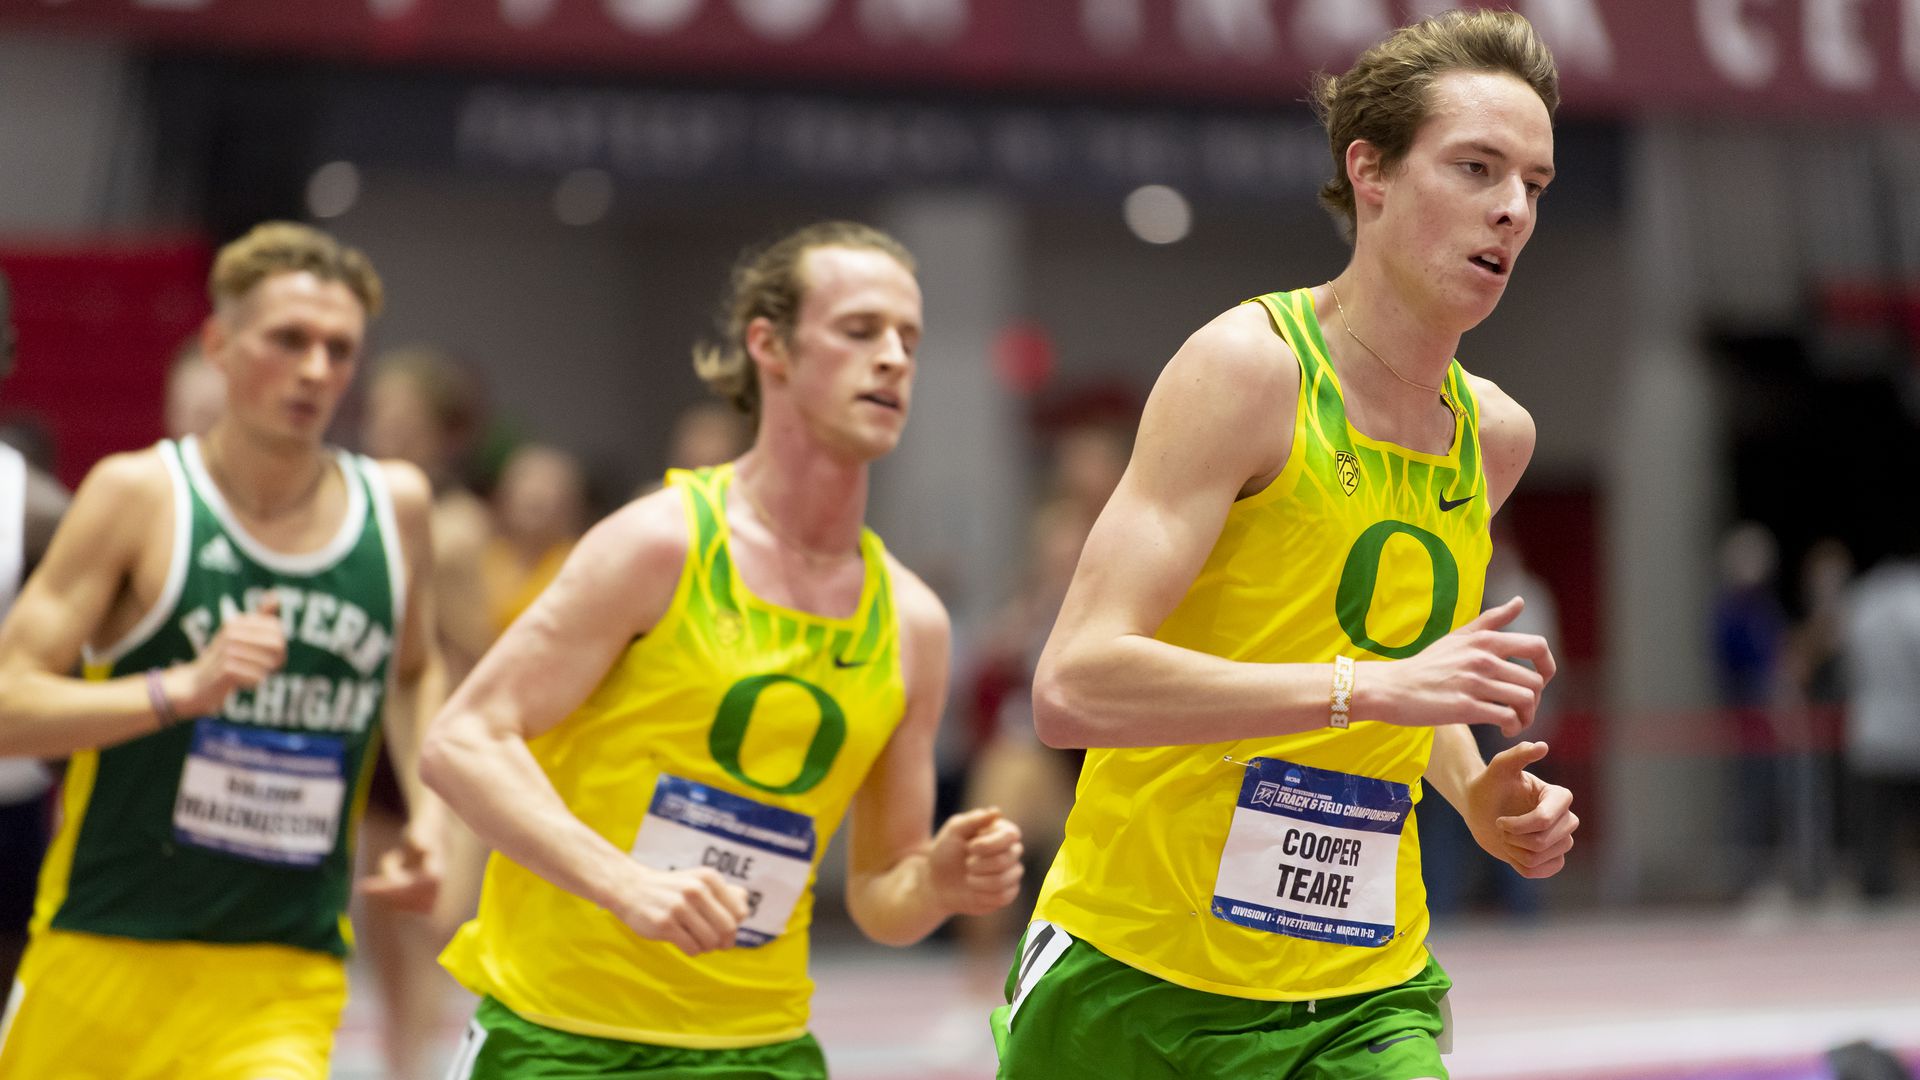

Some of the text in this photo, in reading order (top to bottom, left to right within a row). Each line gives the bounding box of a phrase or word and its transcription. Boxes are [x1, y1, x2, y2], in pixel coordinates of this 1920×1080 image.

[1336, 453, 1359, 480] PAC
[1342, 470, 1355, 487] 12
[1335, 519, 1459, 660] O
[708, 673, 847, 796] O
[1276, 791, 1310, 809] TRACK
[1309, 799, 1319, 810] &
[1318, 800, 1343, 816] FIELD
[1343, 804, 1401, 822] CHAMPIONSHIPS
[702, 846, 754, 880] COLE
[1282, 828, 1362, 867] COOPER
[1276, 863, 1354, 909] TEARE
[1231, 905, 1267, 922] DIVISION
[1336, 925, 1360, 937] MARCH
[1360, 928, 1376, 939] 11-13
